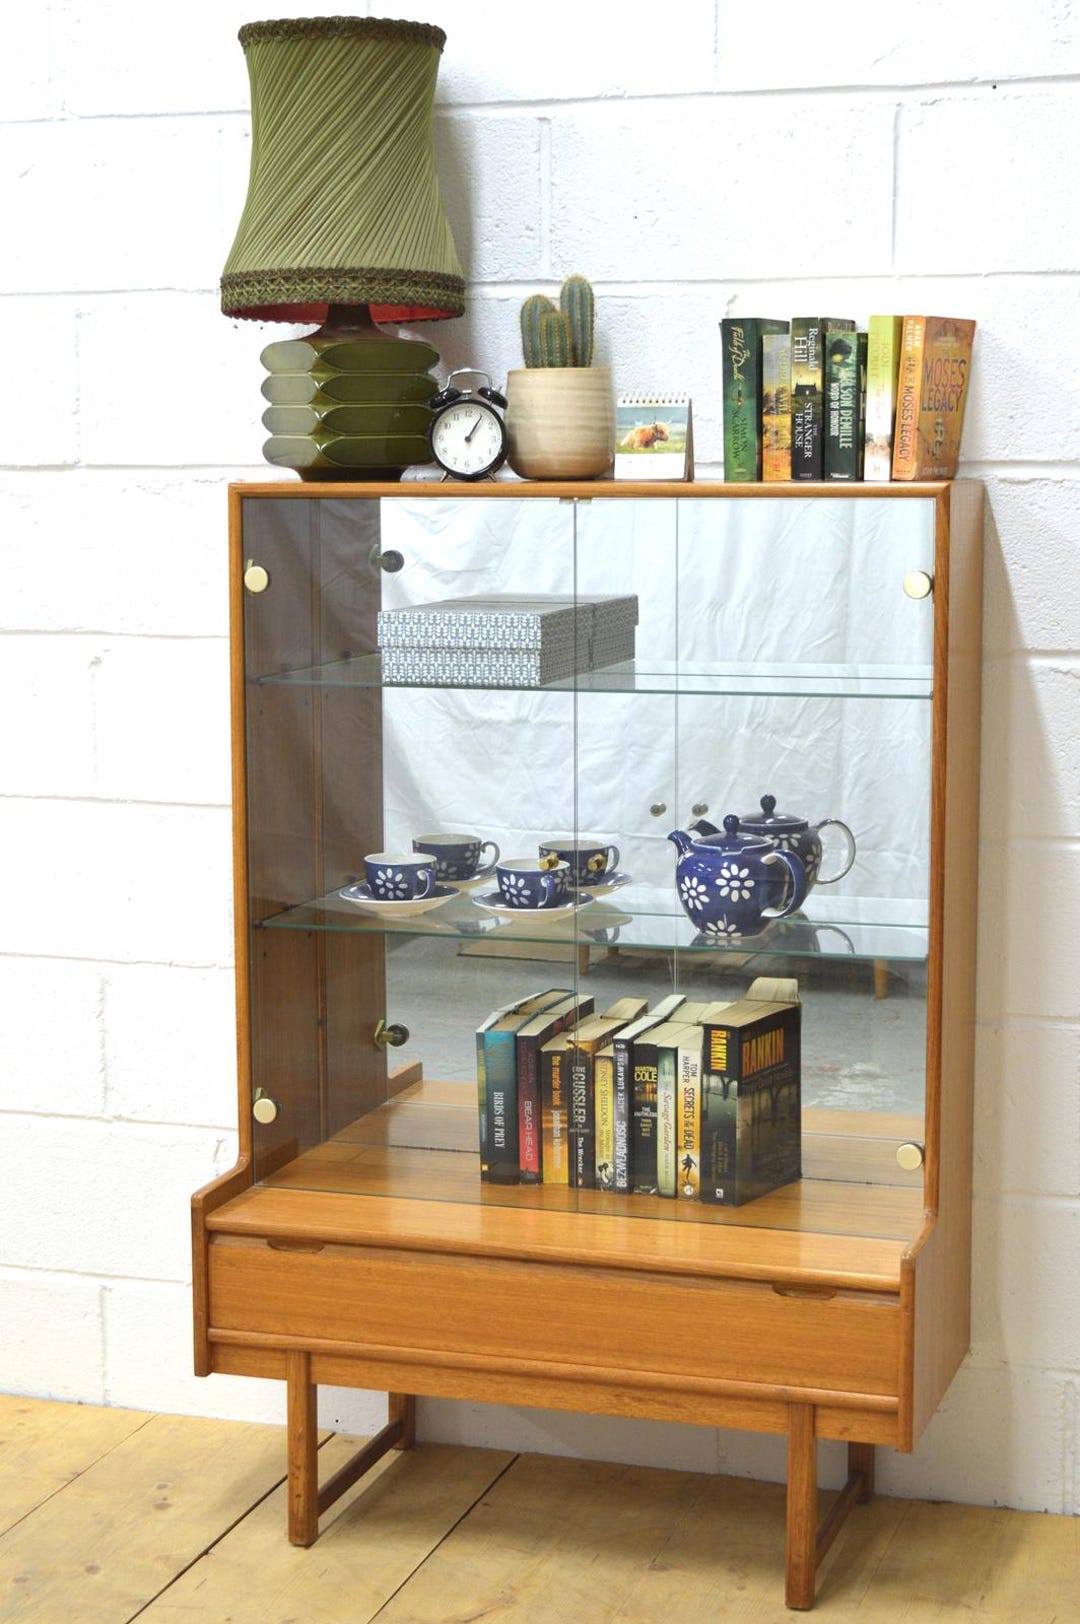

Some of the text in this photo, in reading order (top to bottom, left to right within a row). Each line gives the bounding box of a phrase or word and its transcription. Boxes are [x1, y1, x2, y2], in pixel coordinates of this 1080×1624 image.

[794, 336, 807, 363] Hill
[807, 328, 818, 371] Reginald
[924, 358, 967, 389] MOSES
[830, 383, 840, 437] WORD OF HONOUR
[902, 385, 916, 421] MOSES
[921, 385, 963, 412] LEGACY
[731, 410, 740, 459] SCARROW
[740, 417, 749, 451] SIMON
[795, 413, 804, 449] HOUSE
[803, 402, 813, 458] STRANGER
[839, 410, 853, 449] DEMILLE
[899, 423, 912, 462] LEGACY
[552, 1056, 561, 1065] the
[710, 1030, 727, 1071] RANKIN
[742, 1027, 784, 1077] RANKIN
[552, 1067, 561, 1089] murder
[600, 1060, 609, 1089] SIDNEY
[634, 1071, 657, 1082] COLE
[493, 1092, 504, 1114] BIRDS
[552, 1091, 562, 1105] book
[572, 1073, 586, 1123] CUSSLER
[600, 1089, 610, 1126] SHELDON
[661, 1092, 672, 1122] Savage
[683, 1087, 695, 1119] SECRETS
[494, 1116, 505, 1126] OF
[524, 1100, 533, 1161] BEAR HEAD
[494, 1128, 506, 1149] PREY
[663, 1123, 672, 1152] Garden
[683, 1129, 694, 1149] DEAD
